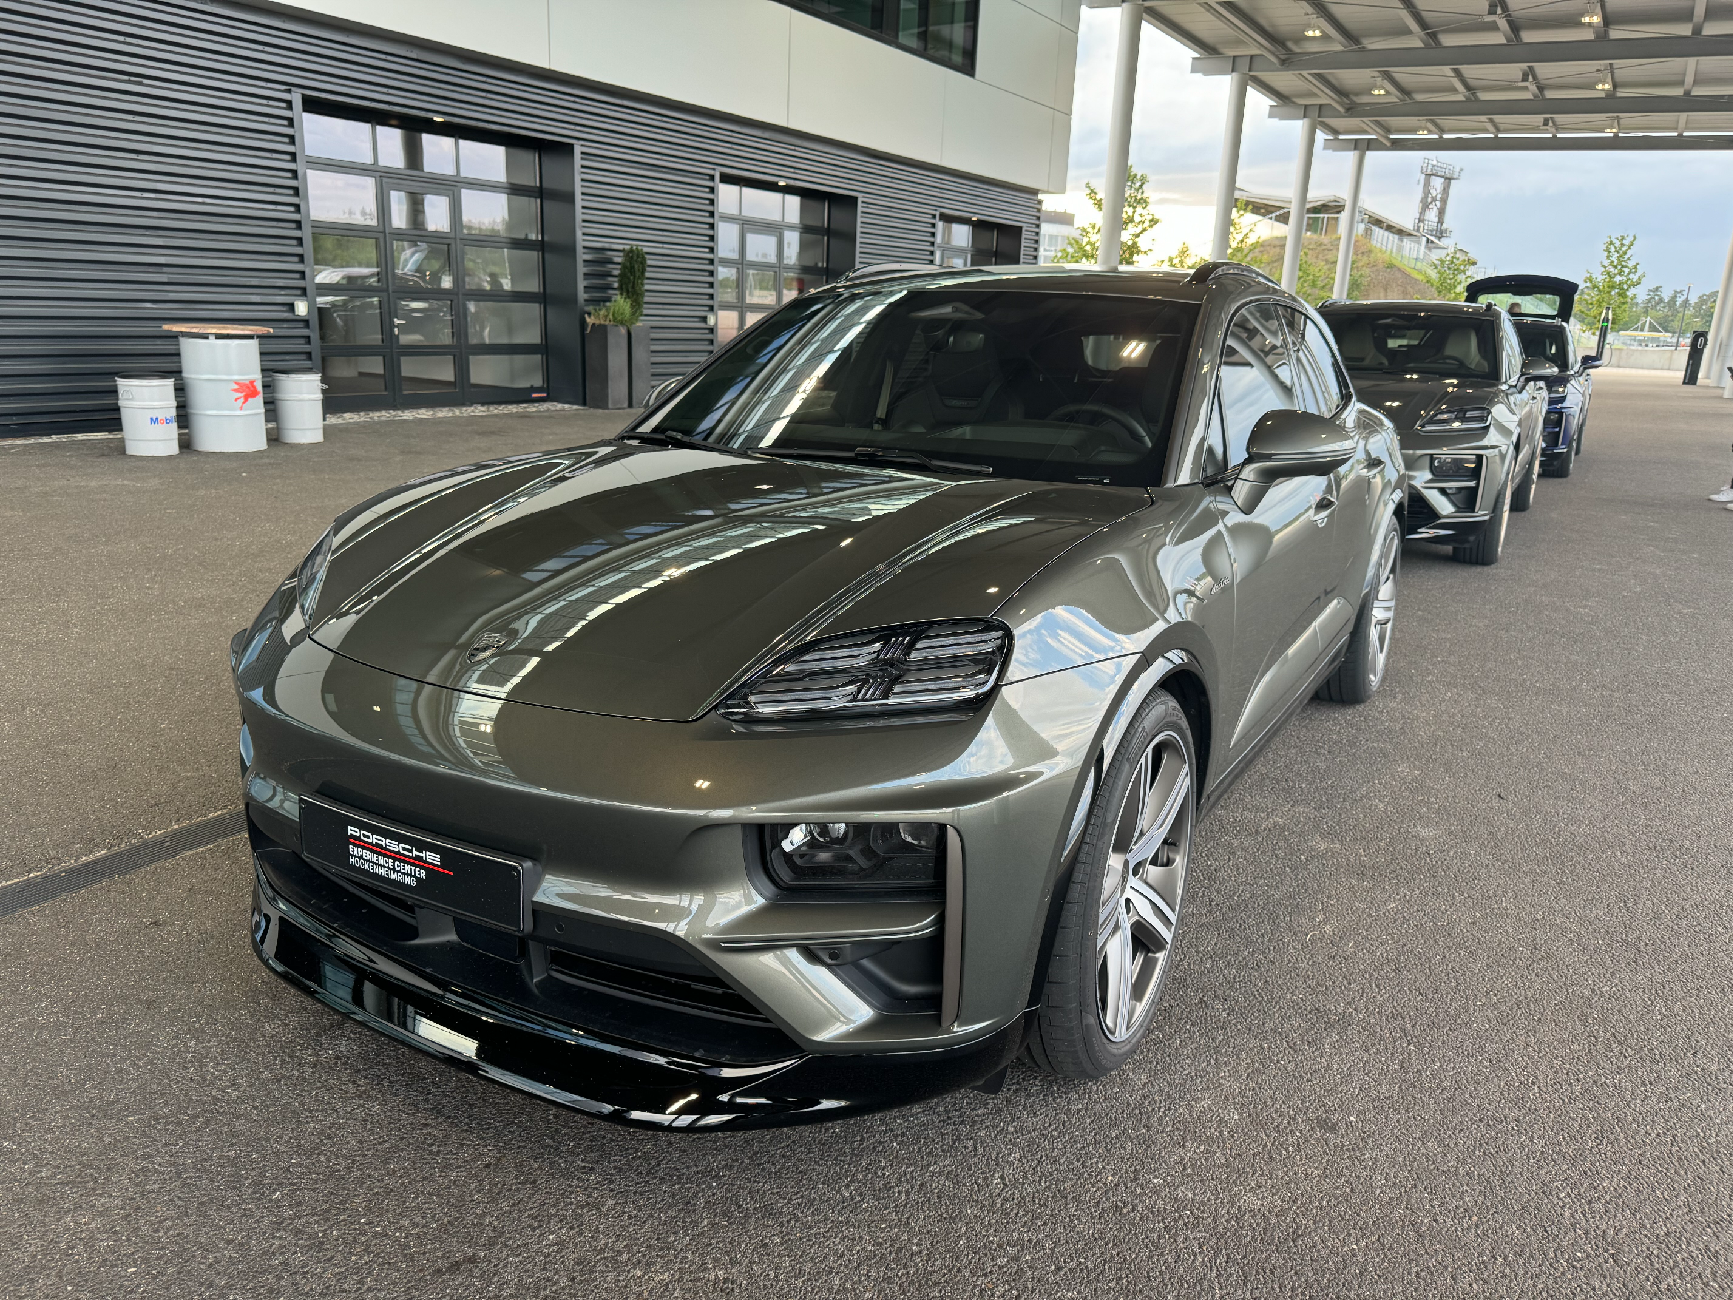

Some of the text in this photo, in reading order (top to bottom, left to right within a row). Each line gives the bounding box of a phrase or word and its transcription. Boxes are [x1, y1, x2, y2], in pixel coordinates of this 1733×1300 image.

[149, 415, 174, 425] Mobil
[347, 825, 441, 866] PORSCHE
[349, 844, 426, 880] EXPERIENCE CENTER
[349, 855, 417, 887] HOCKENHEIMRING
